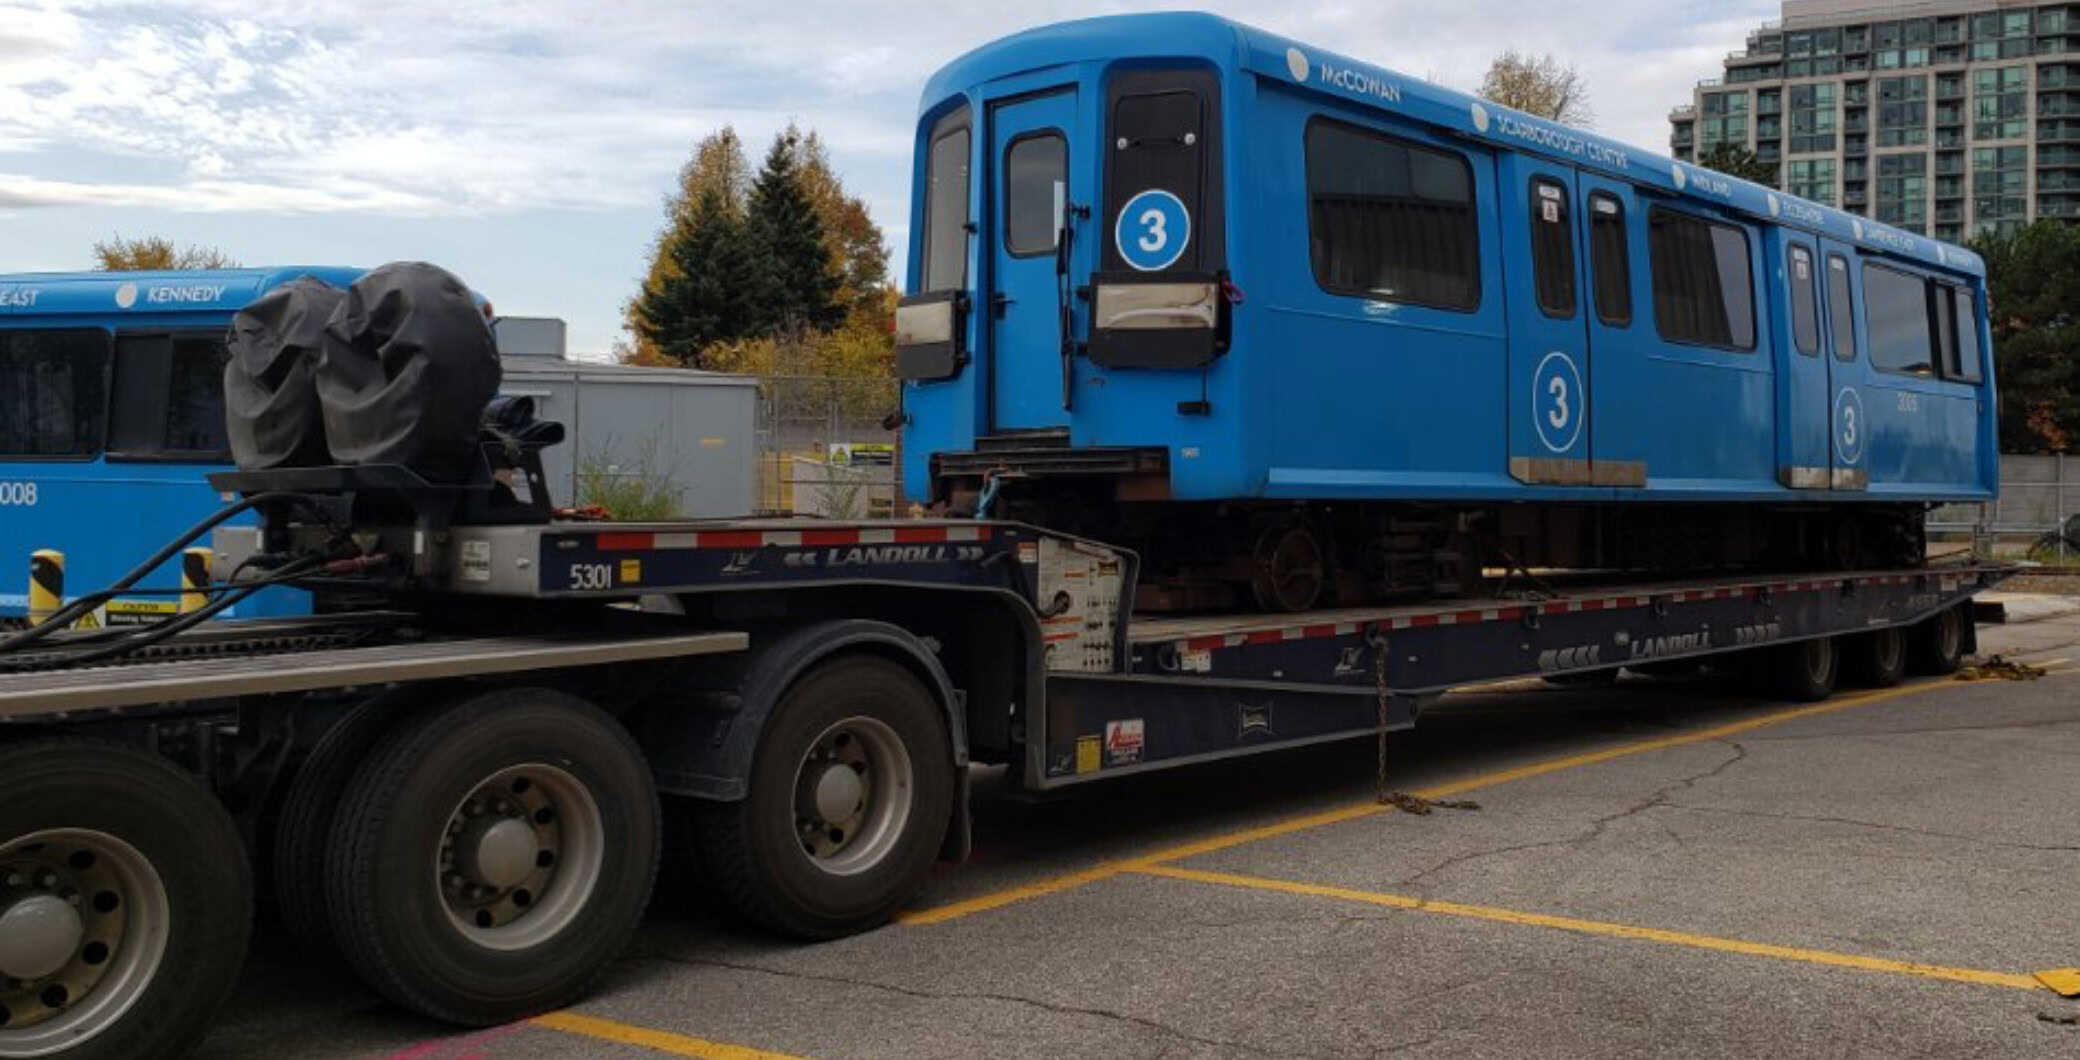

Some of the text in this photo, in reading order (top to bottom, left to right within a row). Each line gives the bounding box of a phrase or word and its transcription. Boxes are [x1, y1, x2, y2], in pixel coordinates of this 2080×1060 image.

[1321, 63, 1401, 105] McCOWAN
[1138, 209, 1167, 252] 3
[0, 289, 39, 307] EAST
[147, 285, 225, 303] KENNEDY
[1549, 376, 1569, 429] 3
[1844, 405, 1856, 446] 3
[0, 481, 38, 506] 008
[827, 546, 950, 566] LANDOLL
[569, 563, 612, 590] 5301
[1631, 631, 1711, 660] LANDOLL
